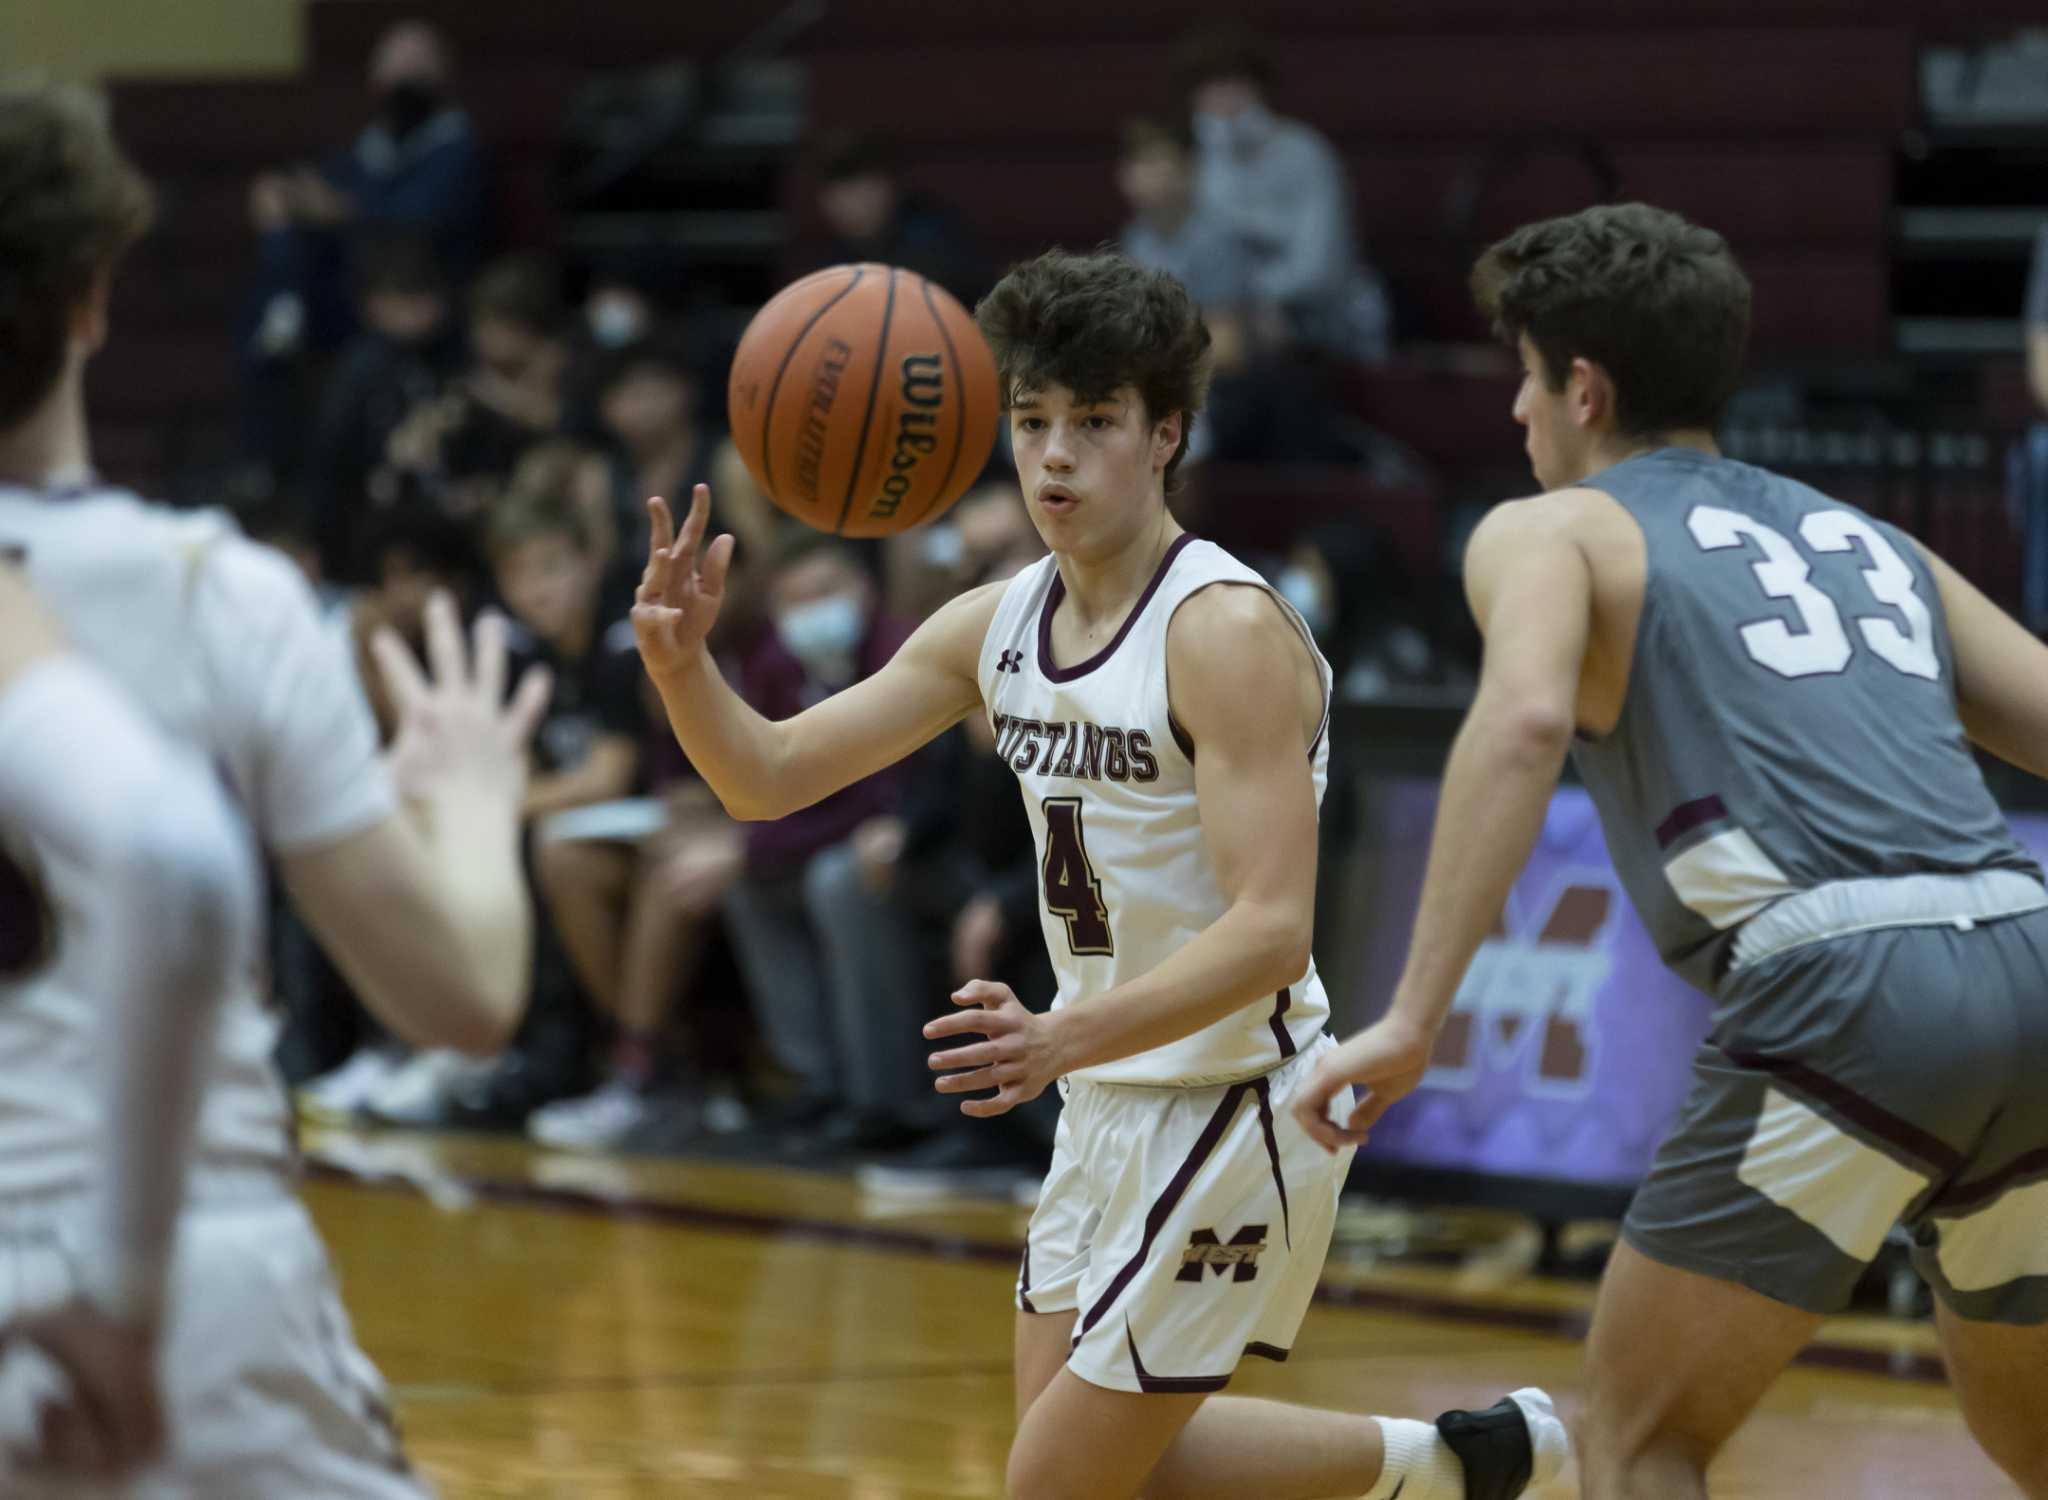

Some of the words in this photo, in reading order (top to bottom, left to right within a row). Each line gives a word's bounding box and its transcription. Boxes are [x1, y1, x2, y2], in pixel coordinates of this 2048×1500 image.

[868, 353, 944, 520] Wilson
[1685, 504, 1942, 681] 33
[1041, 796, 1115, 958] 4
